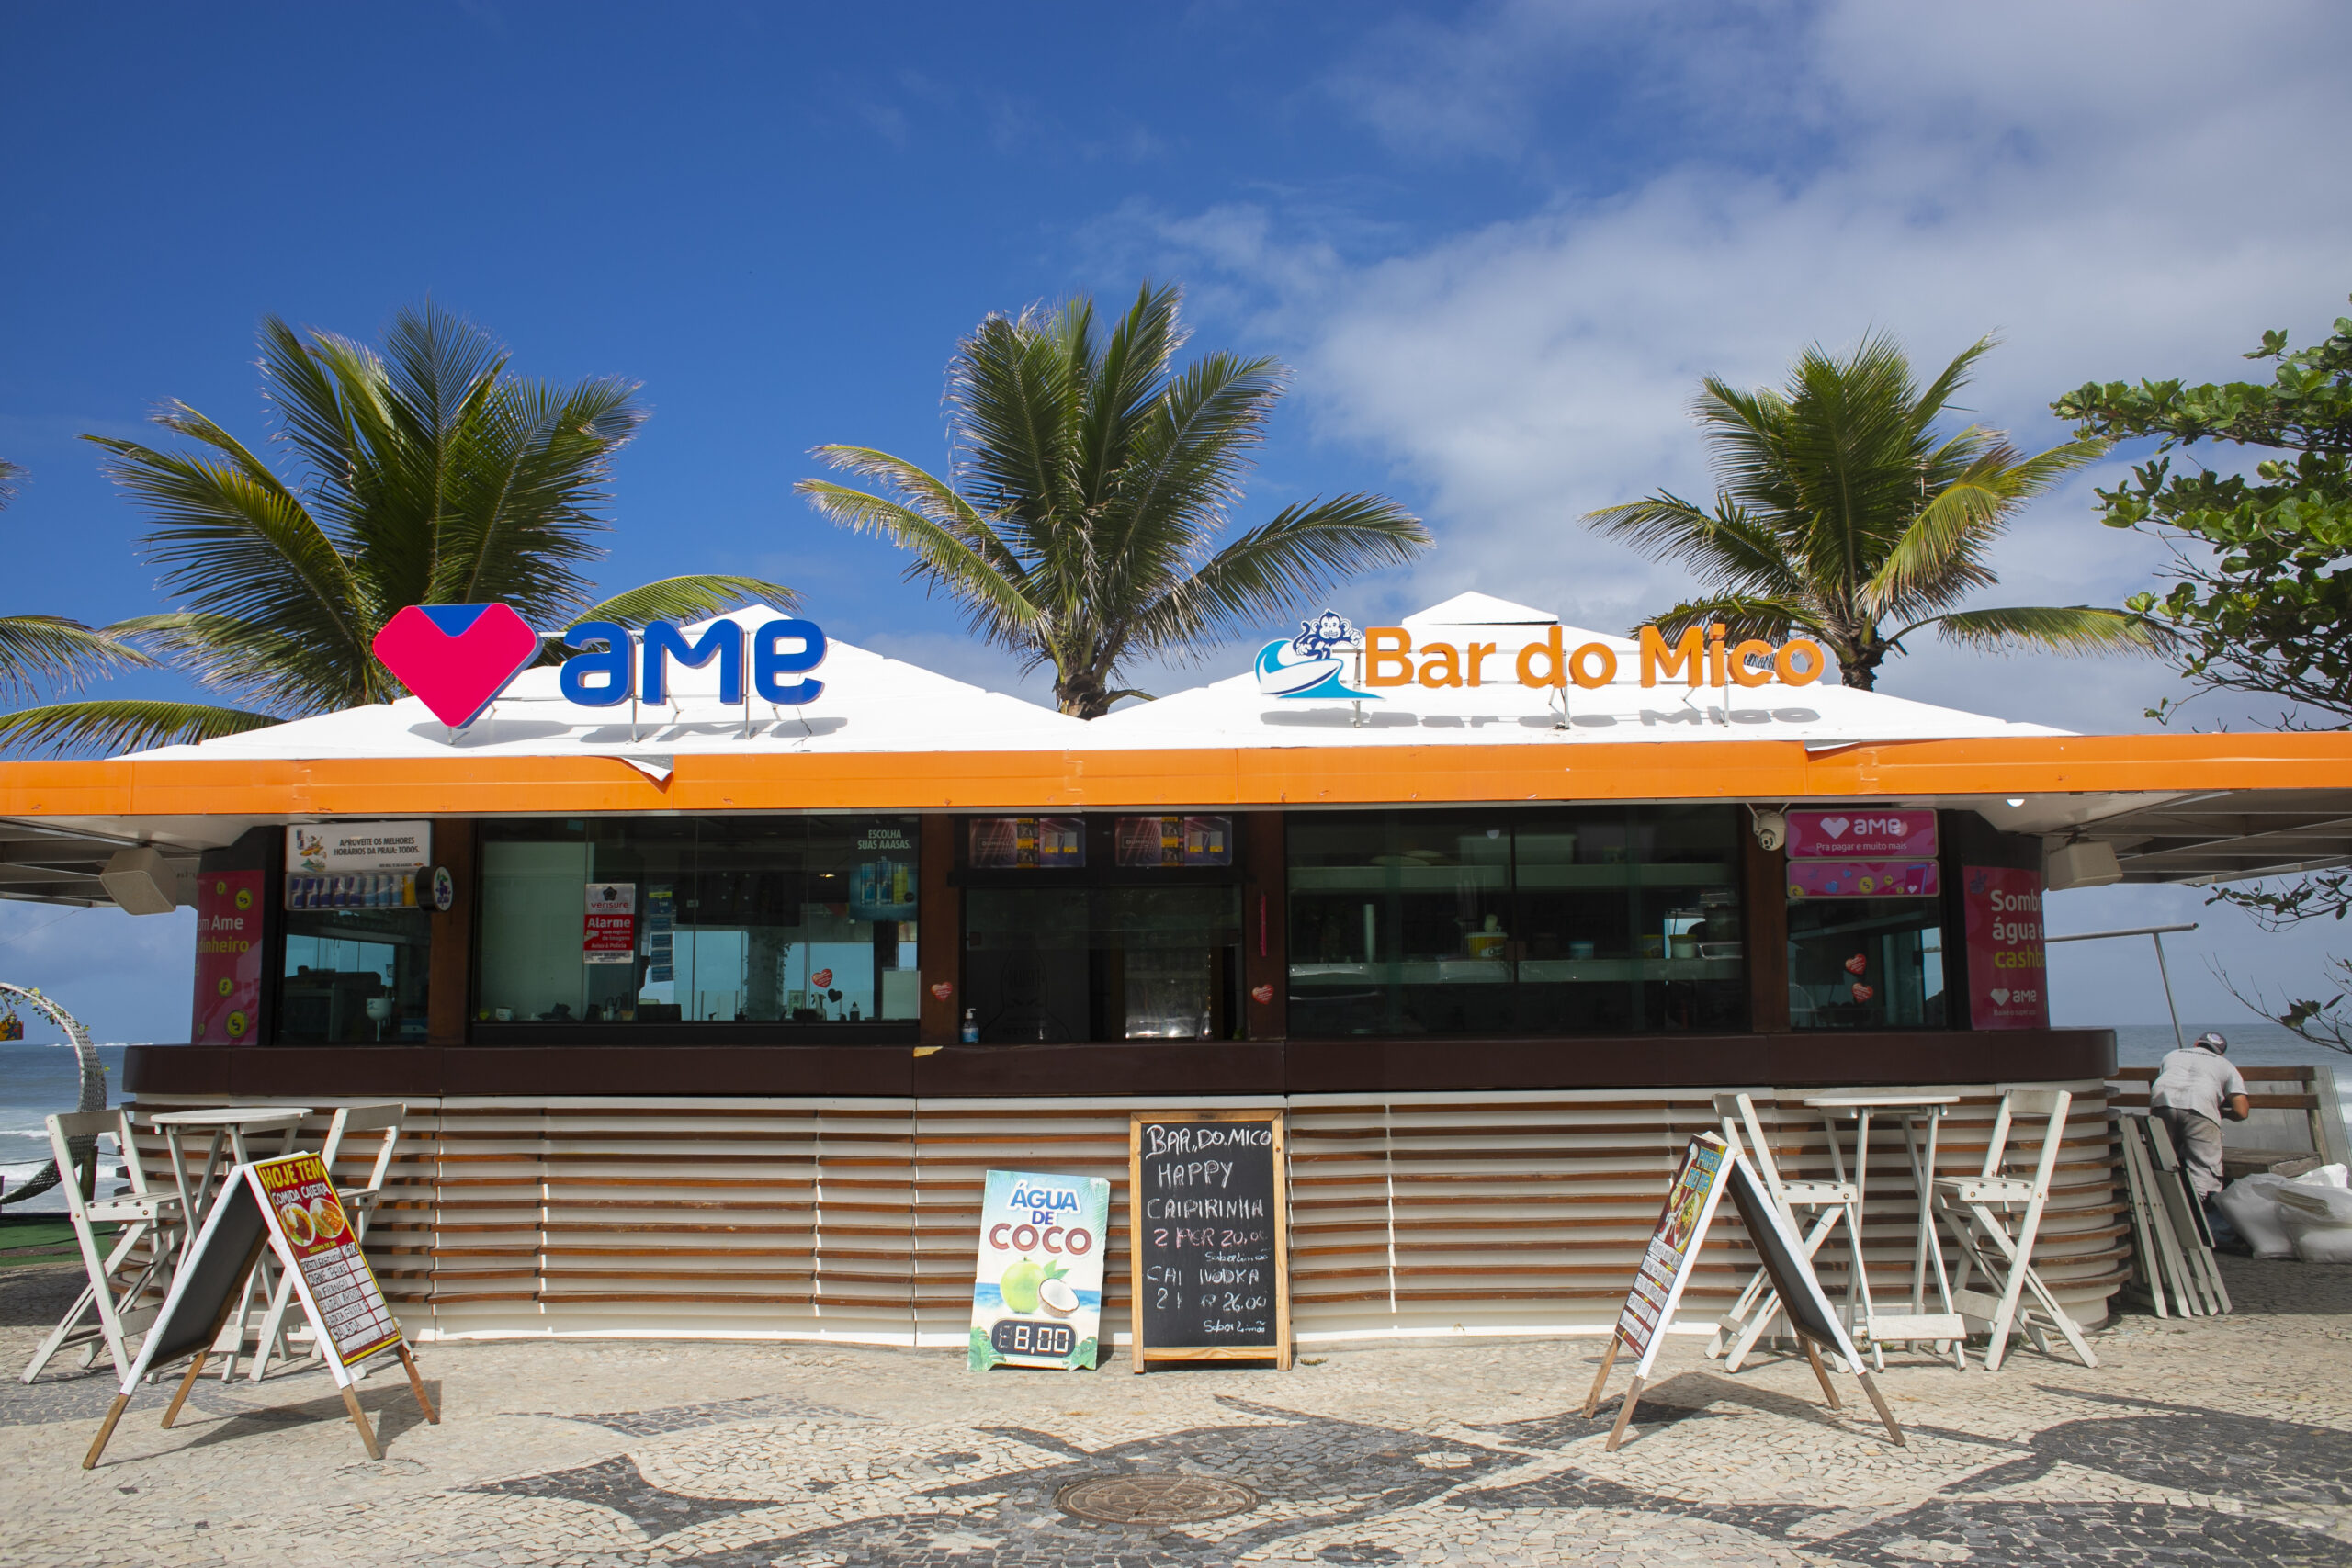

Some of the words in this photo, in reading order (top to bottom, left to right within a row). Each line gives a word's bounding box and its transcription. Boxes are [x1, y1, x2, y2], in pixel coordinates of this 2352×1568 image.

[1365, 626, 1496, 689] Bar
[1516, 626, 1617, 690] do
[1640, 623, 1826, 688] Mico
[339, 838, 372, 846] APROVEITE
[374, 837, 382, 845] OS
[383, 837, 415, 845] MELHORES
[868, 829, 901, 839] ESCOLHA
[334, 847, 366, 856] HORÁRIOS
[367, 847, 376, 855] DA
[857, 840, 877, 850] SUAS
[879, 839, 911, 850] AAASAS.
[1815, 842, 1830, 852] Pra
[1832, 843, 1854, 852] pagar
[1862, 842, 1887, 851] muito
[198, 919, 209, 931] om
[211, 915, 243, 931] Ame
[588, 917, 630, 928] Alarme
[1992, 916, 2036, 945] água
[198, 936, 249, 953] dinheiro
[1995, 947, 2045, 969] cashba
[262, 1164, 299, 1190] HOJE
[295, 1158, 323, 1181] TEM
[1158, 1159, 1233, 1188] HAPPY
[271, 1188, 302, 1205] COMIDA
[1010, 1181, 1078, 1211] ÁGUA
[1147, 1195, 1263, 1219] CAIPIRINHA
[1032, 1210, 1054, 1224] DE
[989, 1223, 1092, 1256] COCO
[1154, 1228, 1169, 1247] 2
[1157, 1288, 1168, 1309] 2
